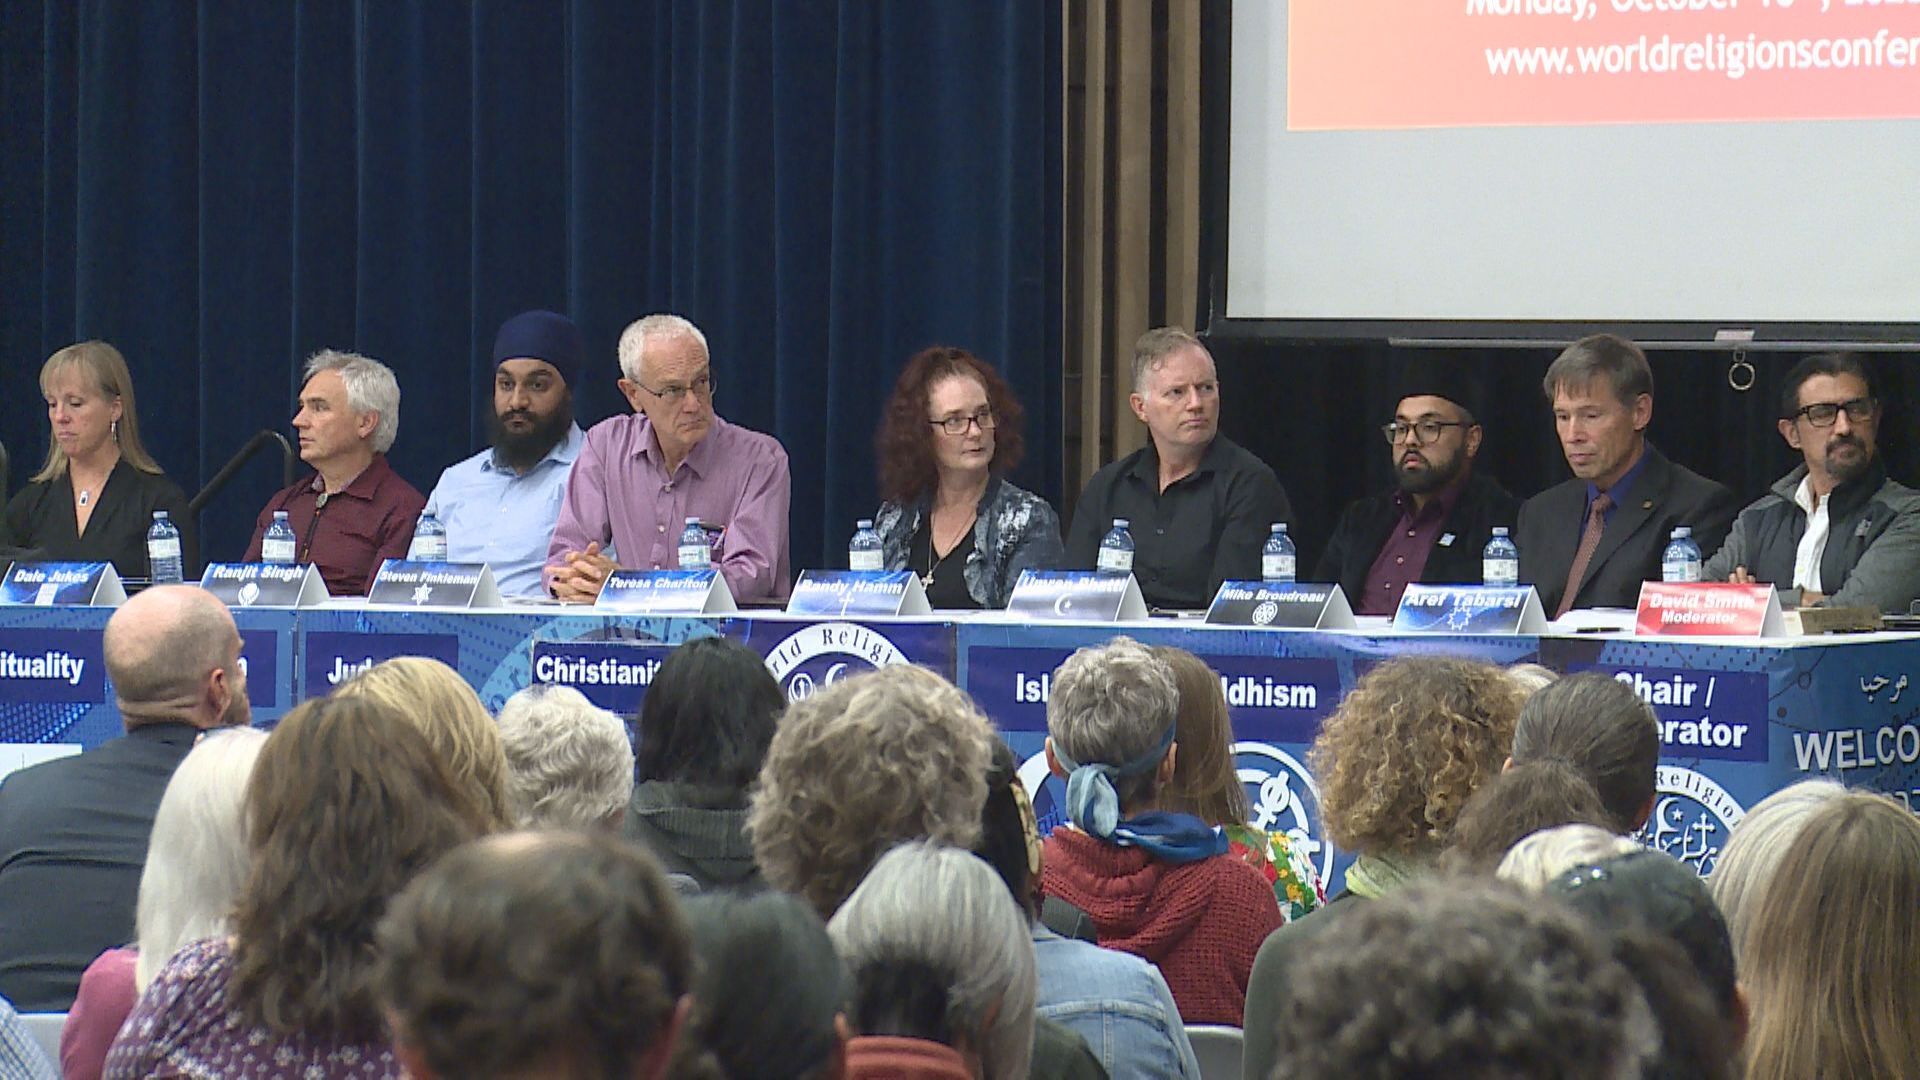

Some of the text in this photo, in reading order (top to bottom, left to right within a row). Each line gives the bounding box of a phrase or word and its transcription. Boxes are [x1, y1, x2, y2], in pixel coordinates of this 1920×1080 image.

[14, 568, 89, 583] Dale Jukes
[212, 565, 304, 582] Ranjit Singh
[852, 580, 903, 594] Hamm
[1222, 589, 1253, 600] Mike
[1405, 592, 1448, 606] Aref
[1650, 590, 1756, 609] David Smith
[1661, 610, 1737, 624] Moderator
[1793, 724, 1920, 771] WELCO
